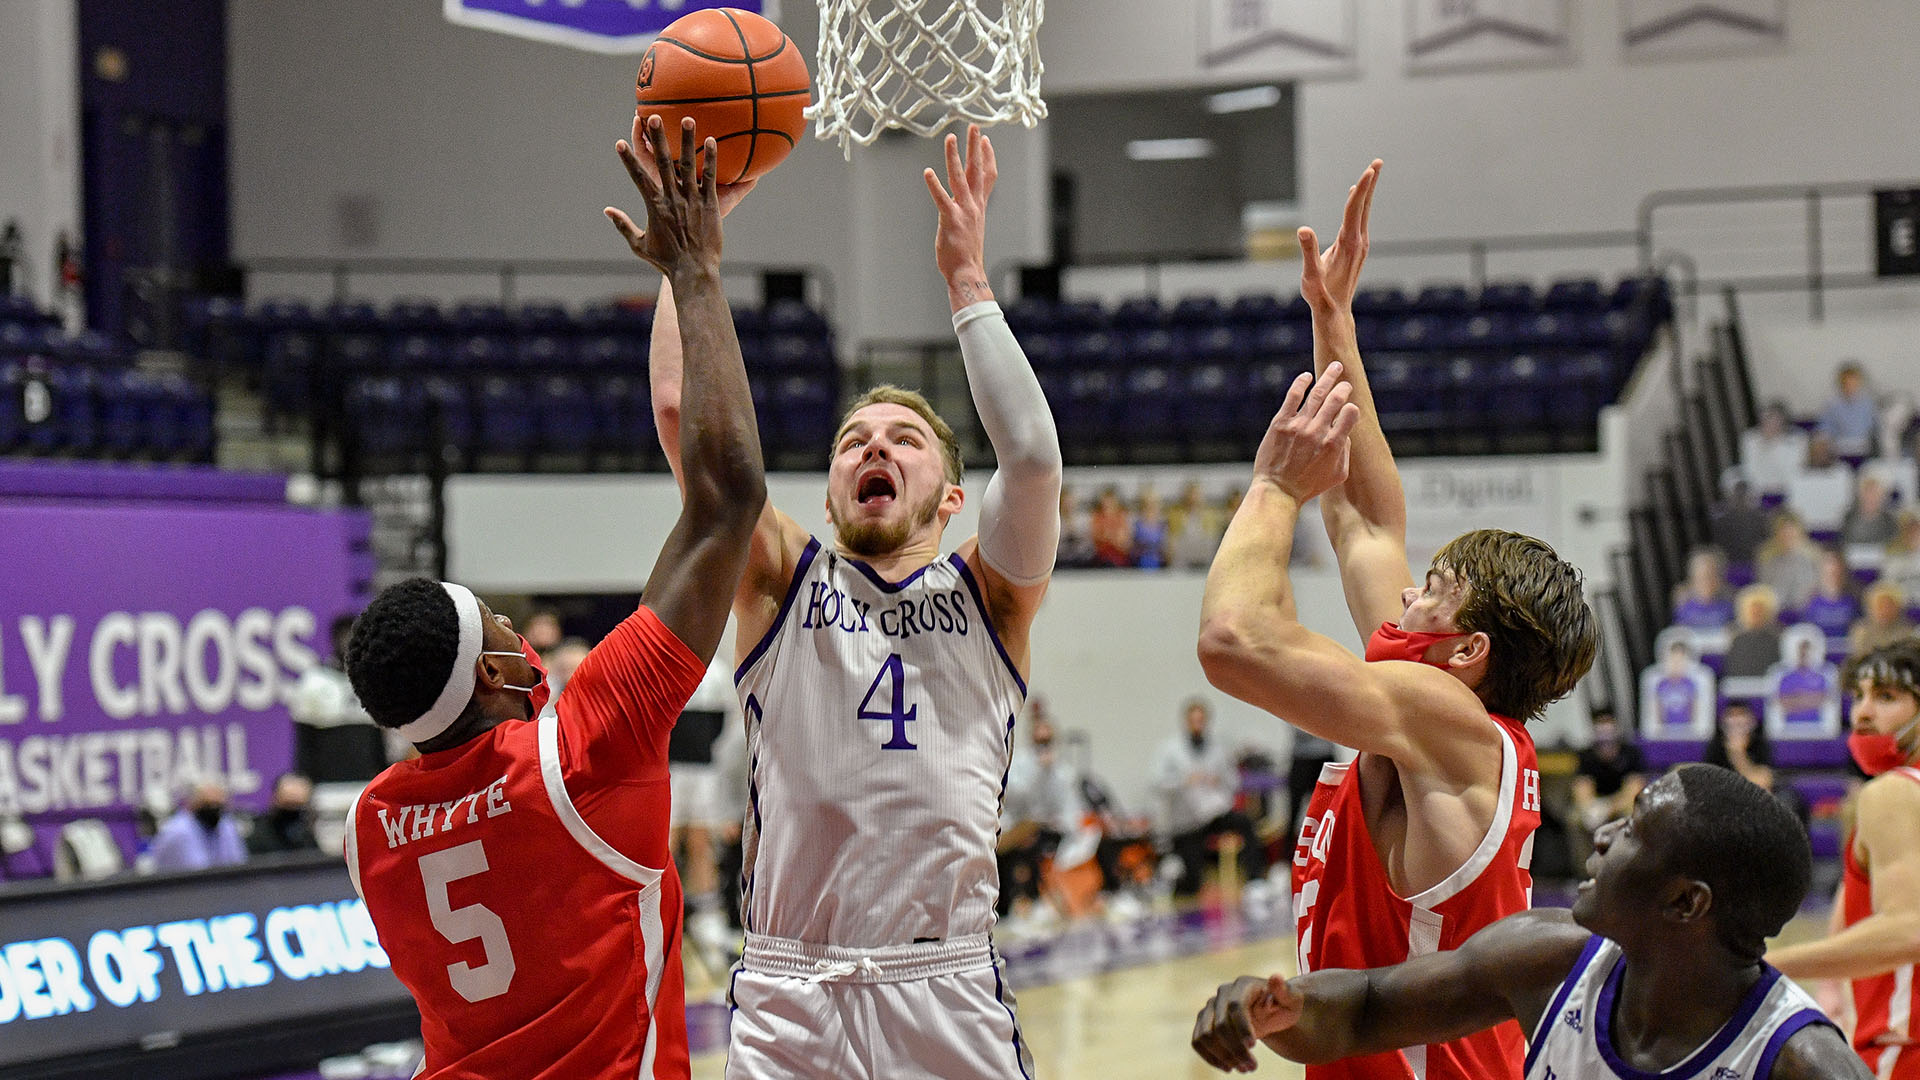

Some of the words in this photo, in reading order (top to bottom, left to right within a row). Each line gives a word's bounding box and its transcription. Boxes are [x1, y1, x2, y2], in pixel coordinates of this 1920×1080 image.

[802, 581, 871, 632] HOLY
[880, 590, 968, 638] CROSS
[88, 605, 319, 720] CROSS
[857, 652, 917, 750] 4
[377, 774, 512, 849] WHYTE
[88, 929, 165, 1007] OF
[156, 912, 275, 996] THE
[418, 839, 516, 1003] 5
